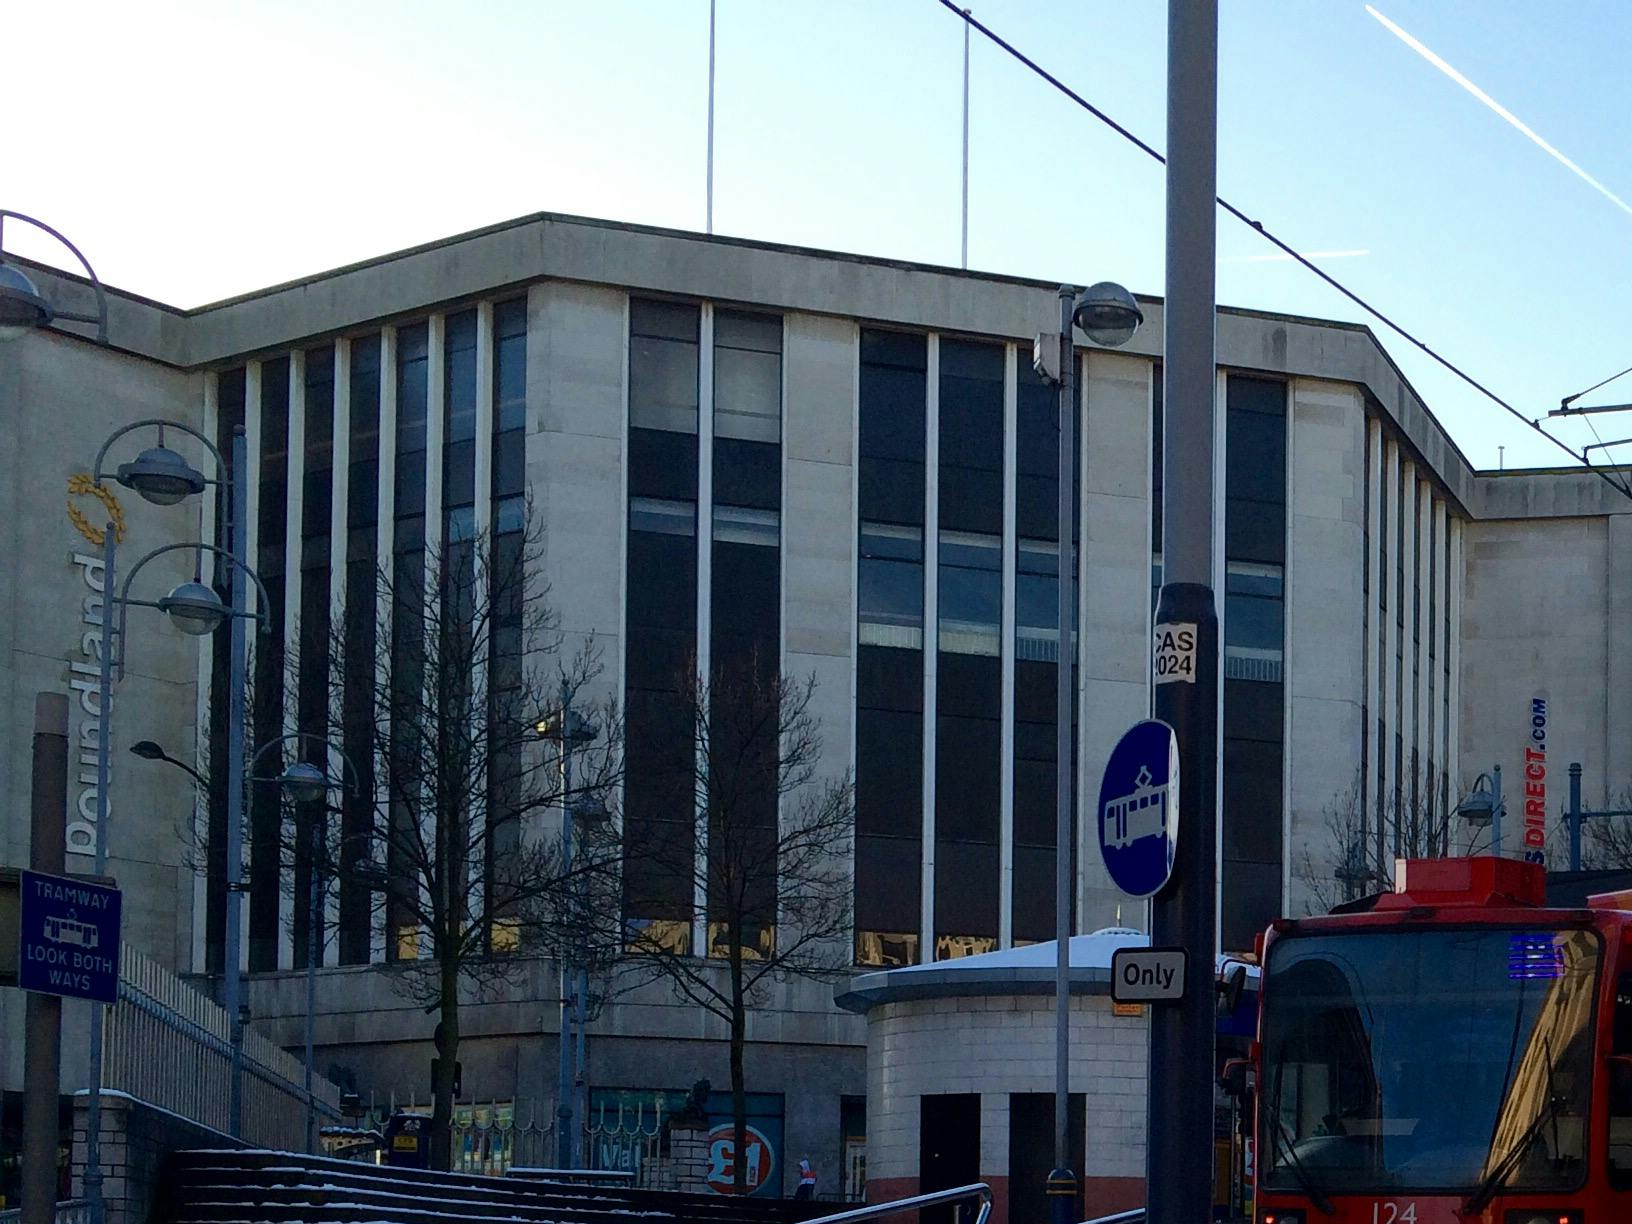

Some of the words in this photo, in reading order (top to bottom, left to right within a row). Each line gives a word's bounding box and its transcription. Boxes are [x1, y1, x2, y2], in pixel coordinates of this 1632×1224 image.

[66, 552, 116, 858] Poundland
[34, 880, 109, 909] TRAMWAY
[27, 943, 67, 966] LOOK
[73, 951, 112, 974] BOTH
[48, 969, 91, 991] WAYS
[1124, 963, 1175, 989] Only
